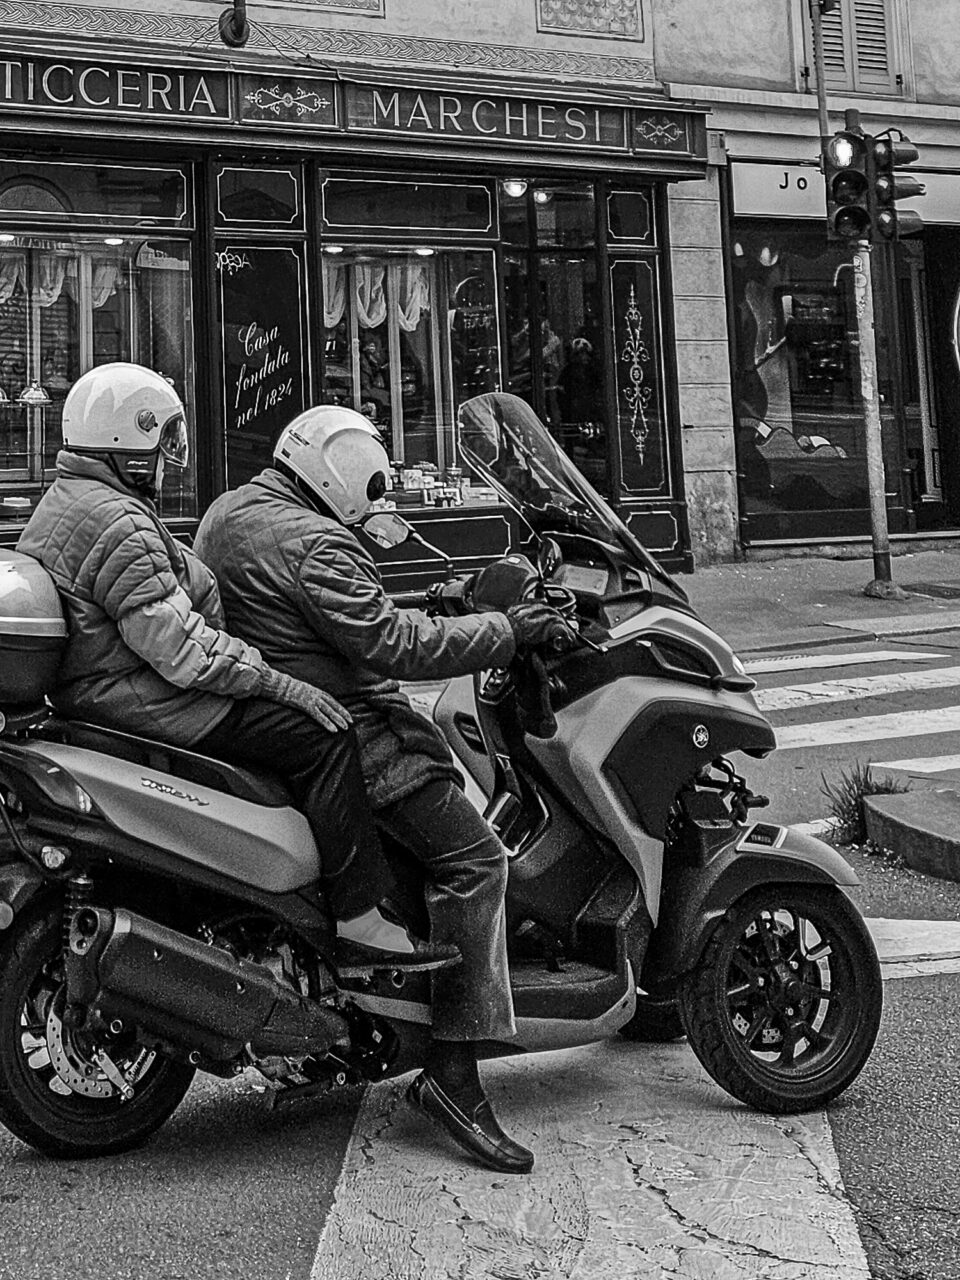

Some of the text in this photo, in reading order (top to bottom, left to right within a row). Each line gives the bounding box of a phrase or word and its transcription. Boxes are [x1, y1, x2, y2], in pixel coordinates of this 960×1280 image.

[372, 90, 602, 141] MARCHESI
[238, 322, 279, 356] Casa
[235, 345, 290, 409] fondata
[237, 378, 292, 428] nel 1824
